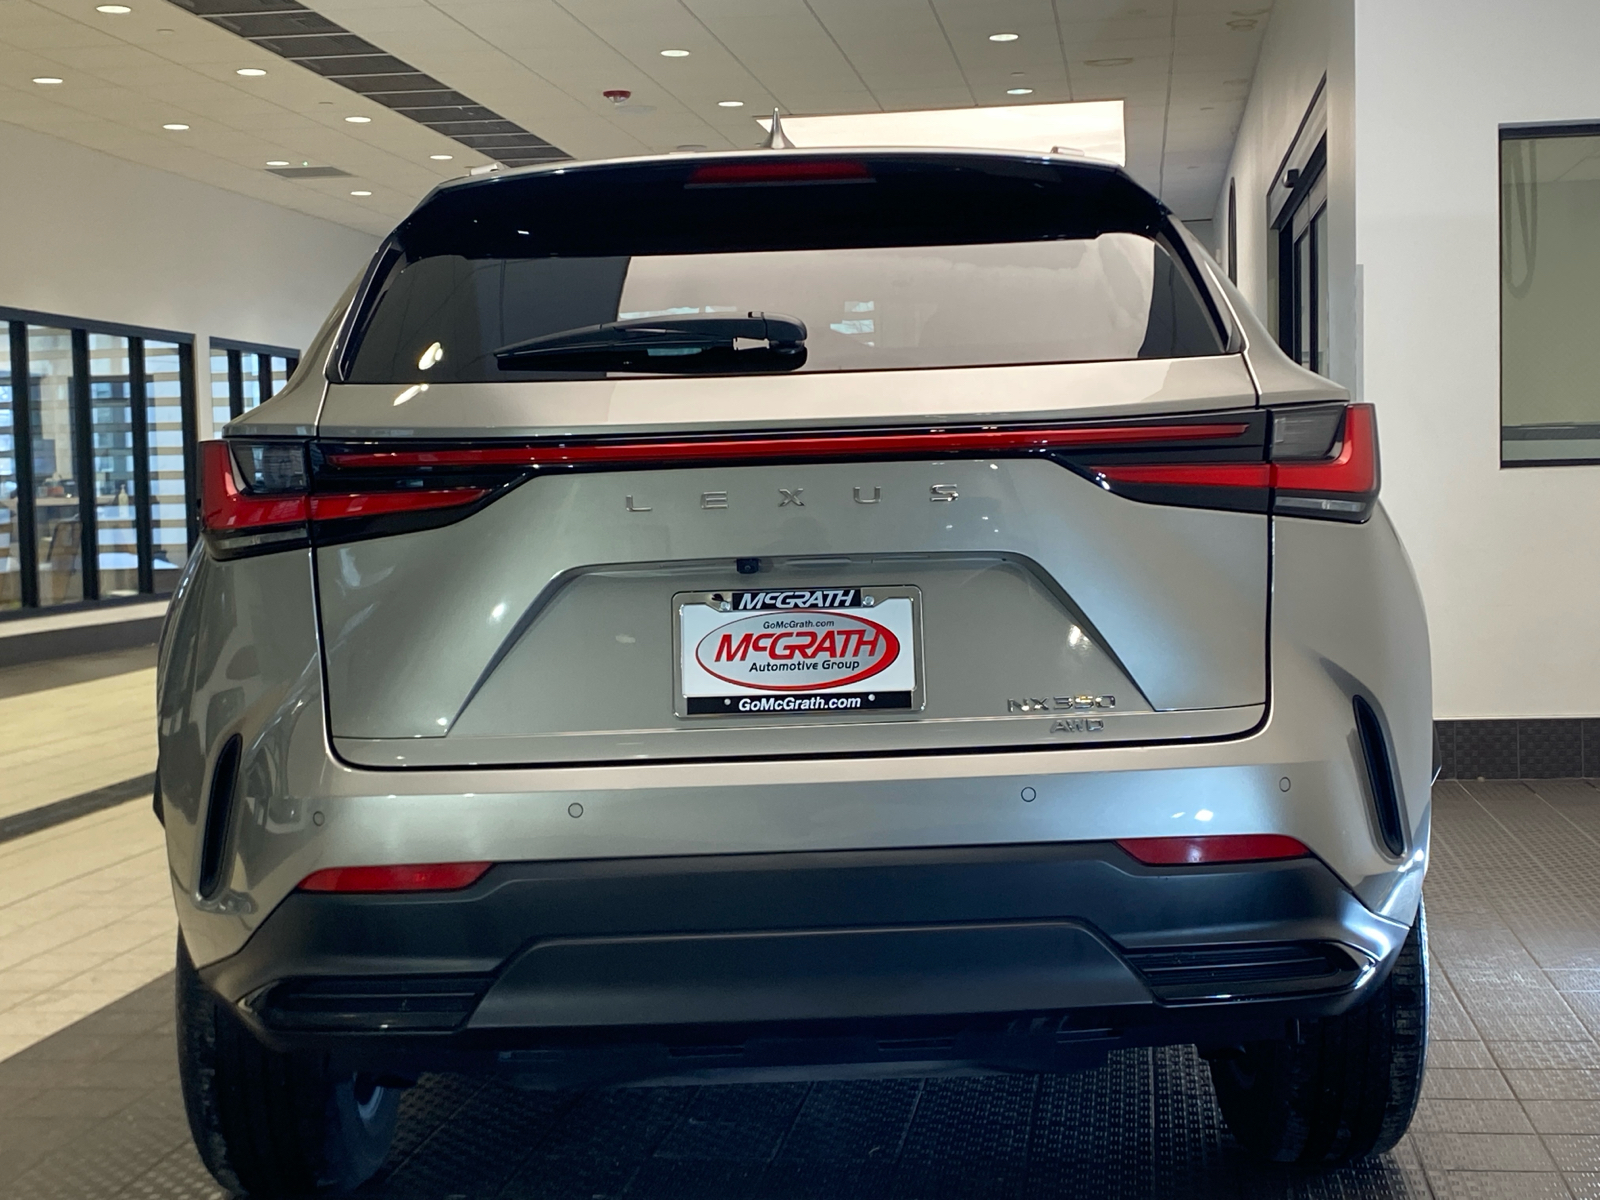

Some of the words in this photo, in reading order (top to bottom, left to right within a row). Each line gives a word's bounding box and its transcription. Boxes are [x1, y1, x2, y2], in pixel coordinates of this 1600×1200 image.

[625, 483, 959, 513] LEXUS
[762, 619, 835, 631] GoMcGrath.com
[749, 661, 819, 673] Automotive
[821, 659, 860, 672] Group
[738, 696, 862, 712] GoMcGrath.com
[1049, 718, 1105, 734] AWD
